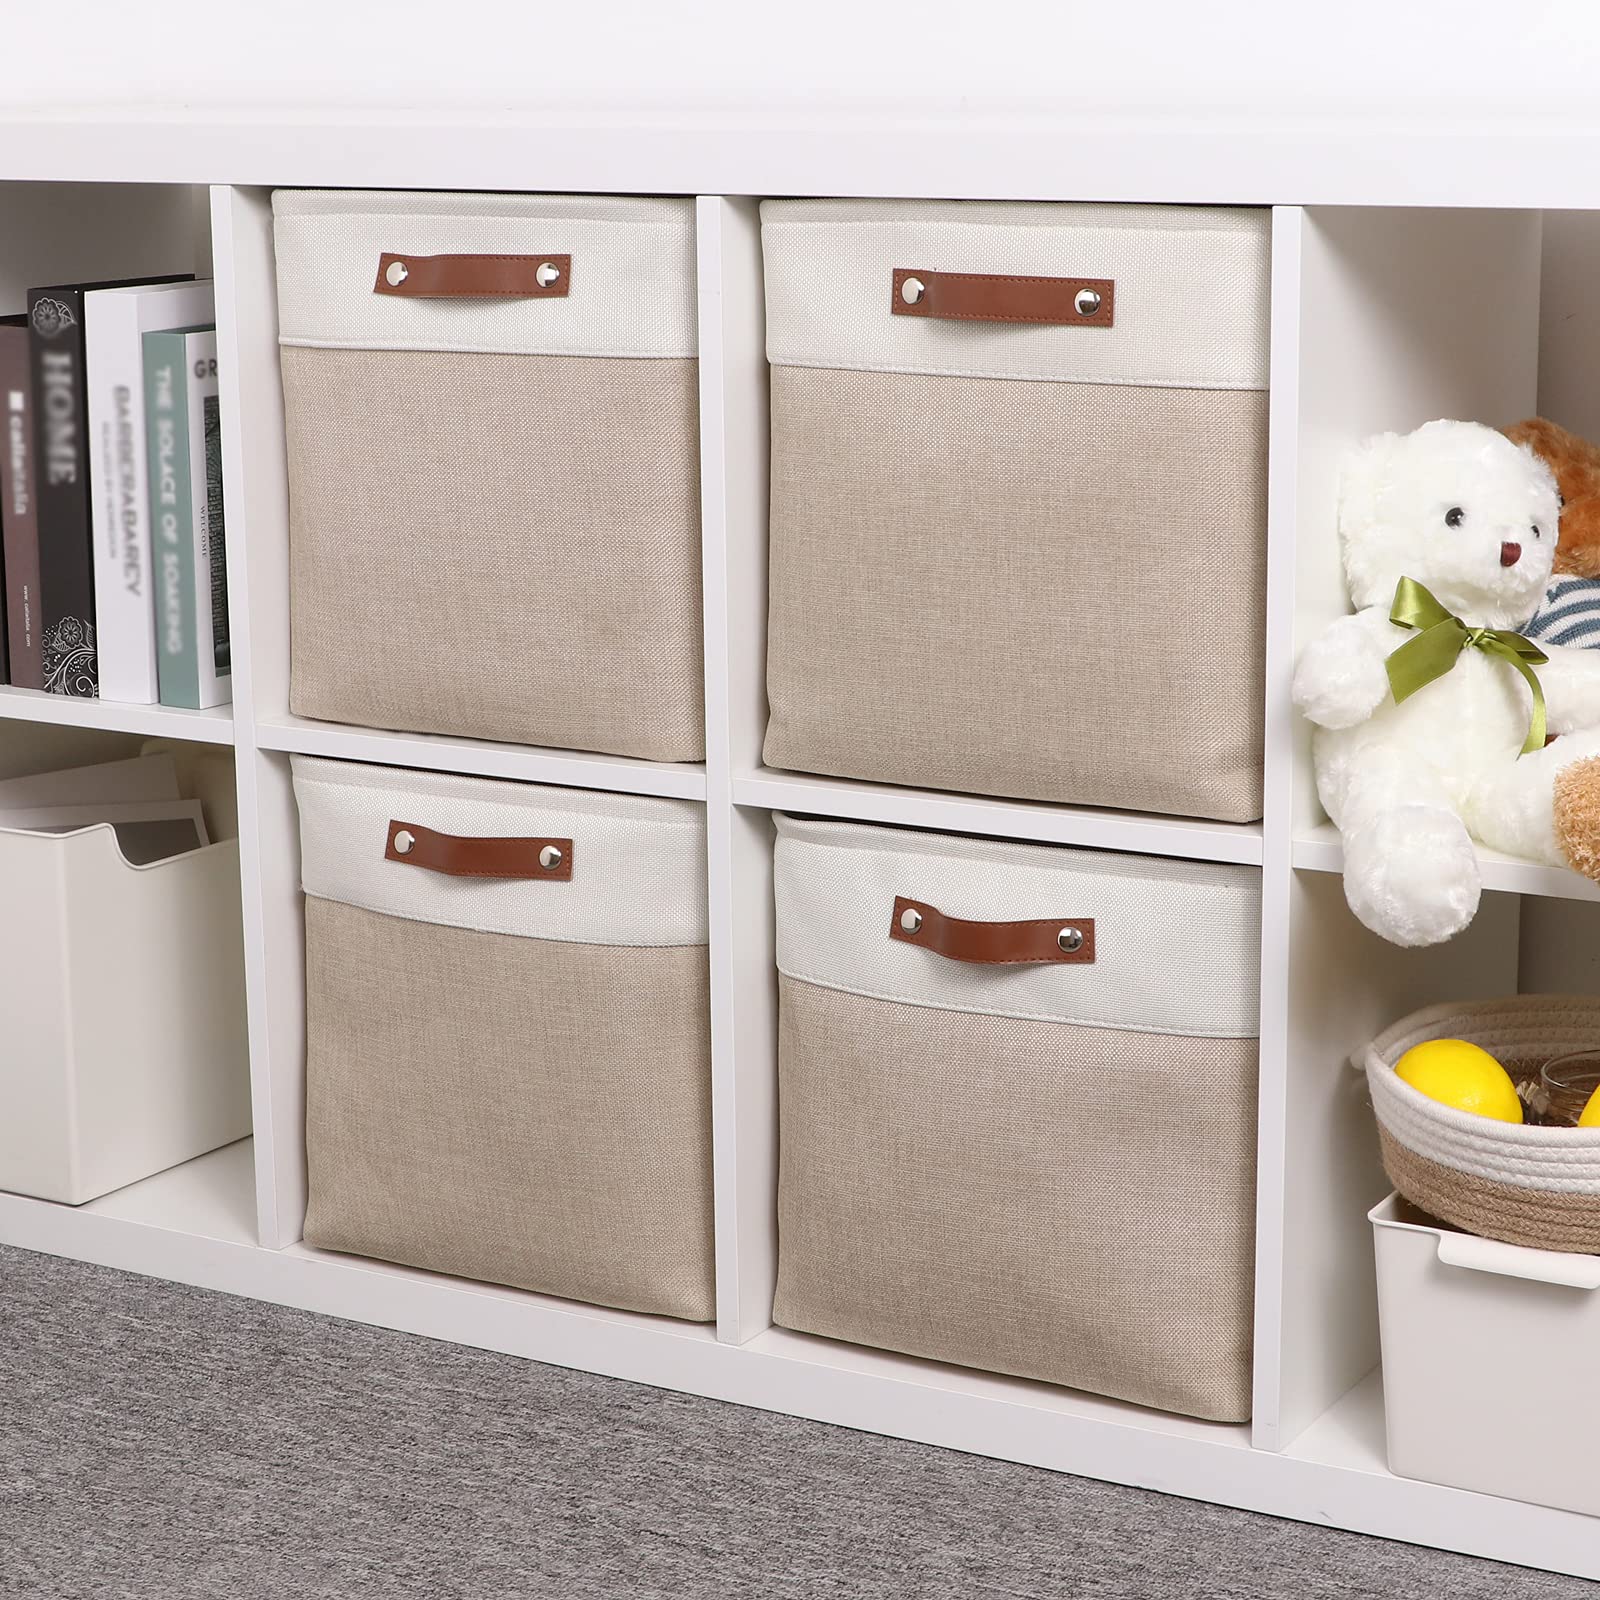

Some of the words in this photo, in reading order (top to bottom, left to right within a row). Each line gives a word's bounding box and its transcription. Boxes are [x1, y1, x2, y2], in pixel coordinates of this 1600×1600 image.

[155, 364, 173, 411] THE
[42, 352, 77, 485] HOME
[156, 417, 176, 506] SOLACE
[162, 513, 178, 544] OF
[200, 505, 208, 558] WELCOME
